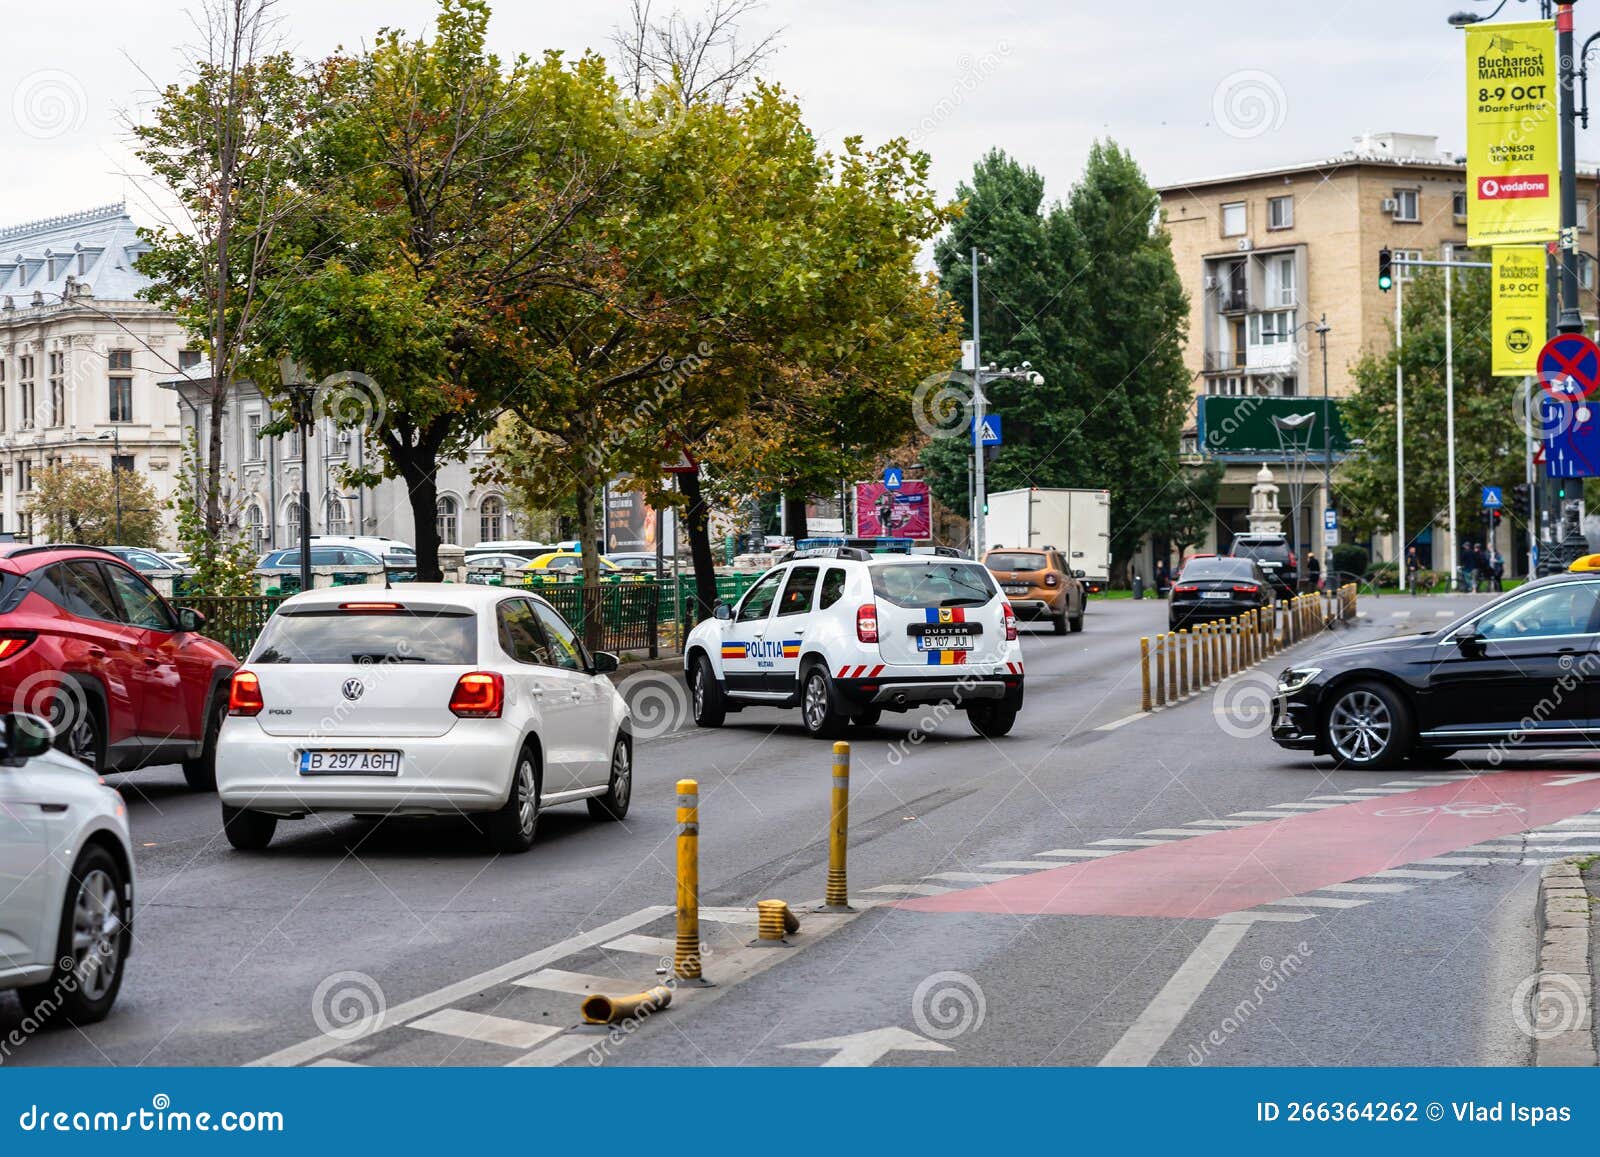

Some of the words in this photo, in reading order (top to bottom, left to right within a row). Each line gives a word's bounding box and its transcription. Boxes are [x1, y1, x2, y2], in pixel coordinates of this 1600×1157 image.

[1478, 54, 1543, 69] Bucharest
[1478, 66, 1545, 80] MARATHON
[1478, 87, 1506, 102] 8-9
[1511, 85, 1546, 100] OCT
[1478, 102, 1546, 113] #DareFurther
[1490, 144, 1535, 153] SPONSOR
[1511, 153, 1534, 161] RACE
[1500, 181, 1545, 191] vodafone
[1518, 283, 1539, 292] OCT
[924, 636, 932, 647] B
[935, 636, 949, 647] 107
[745, 641, 784, 658] POLITIA
[268, 708, 293, 716] POLO
[311, 753, 323, 769] B
[328, 753, 358, 769] 297
[360, 753, 395, 770] AGH
